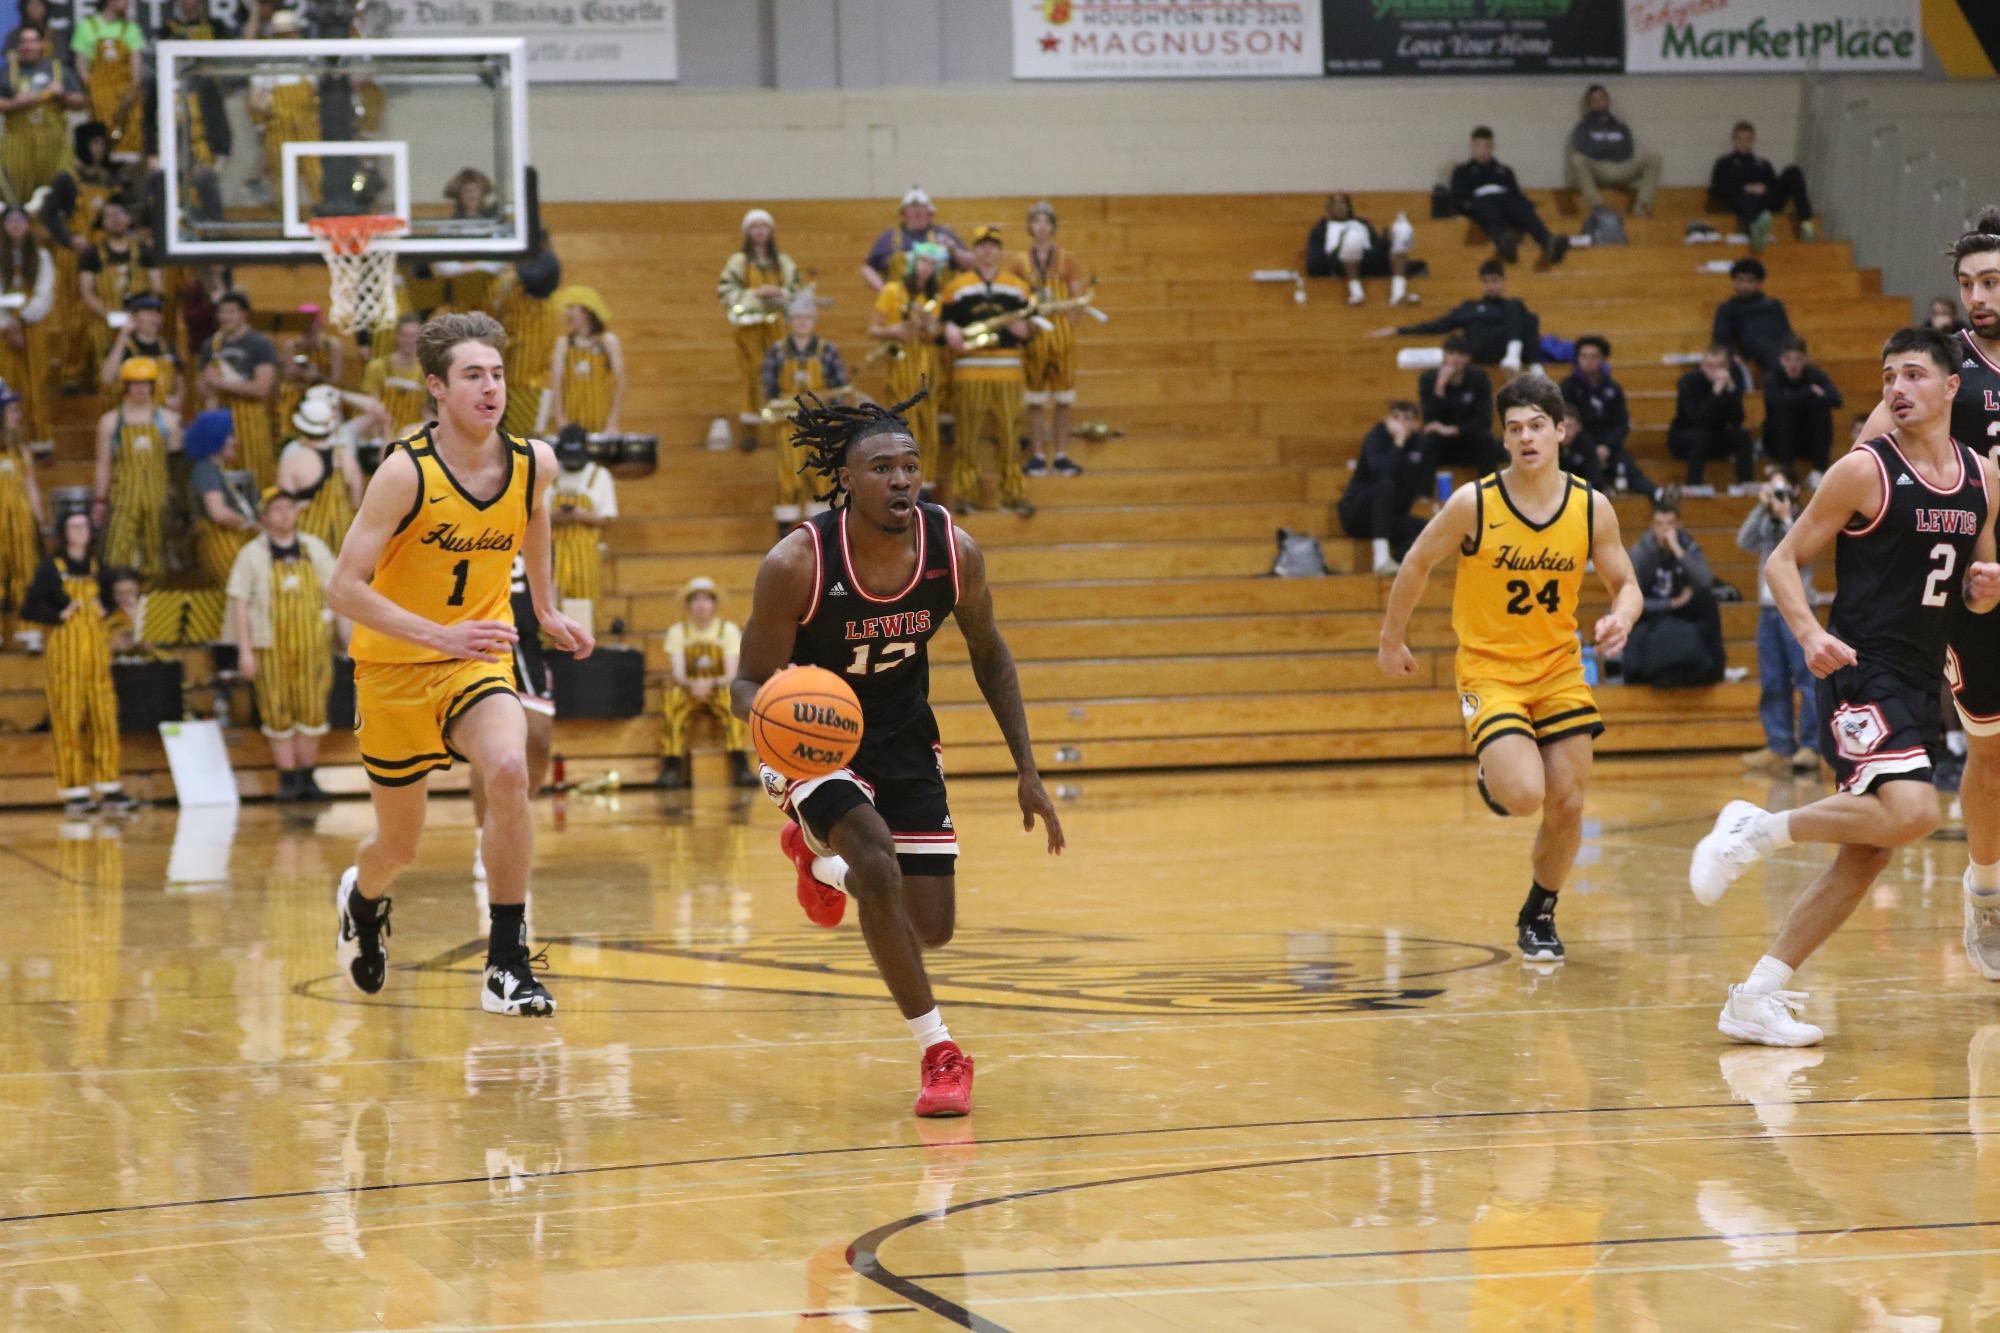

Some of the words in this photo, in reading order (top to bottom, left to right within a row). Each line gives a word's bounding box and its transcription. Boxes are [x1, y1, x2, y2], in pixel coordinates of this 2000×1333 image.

[1071, 31, 1304, 55] MAGNUSON
[1661, 17, 1914, 58] MarketPlace
[1916, 509, 1977, 535] LEWIS
[421, 523, 514, 552] Huskies
[1492, 545, 1576, 571] Huskies
[447, 559, 469, 606] 1
[1921, 542, 1956, 607] 2
[1507, 579, 1560, 615] 24
[845, 610, 931, 640] LEWIS
[793, 703, 859, 735] Wilson
[792, 743, 844, 764] NCAA
